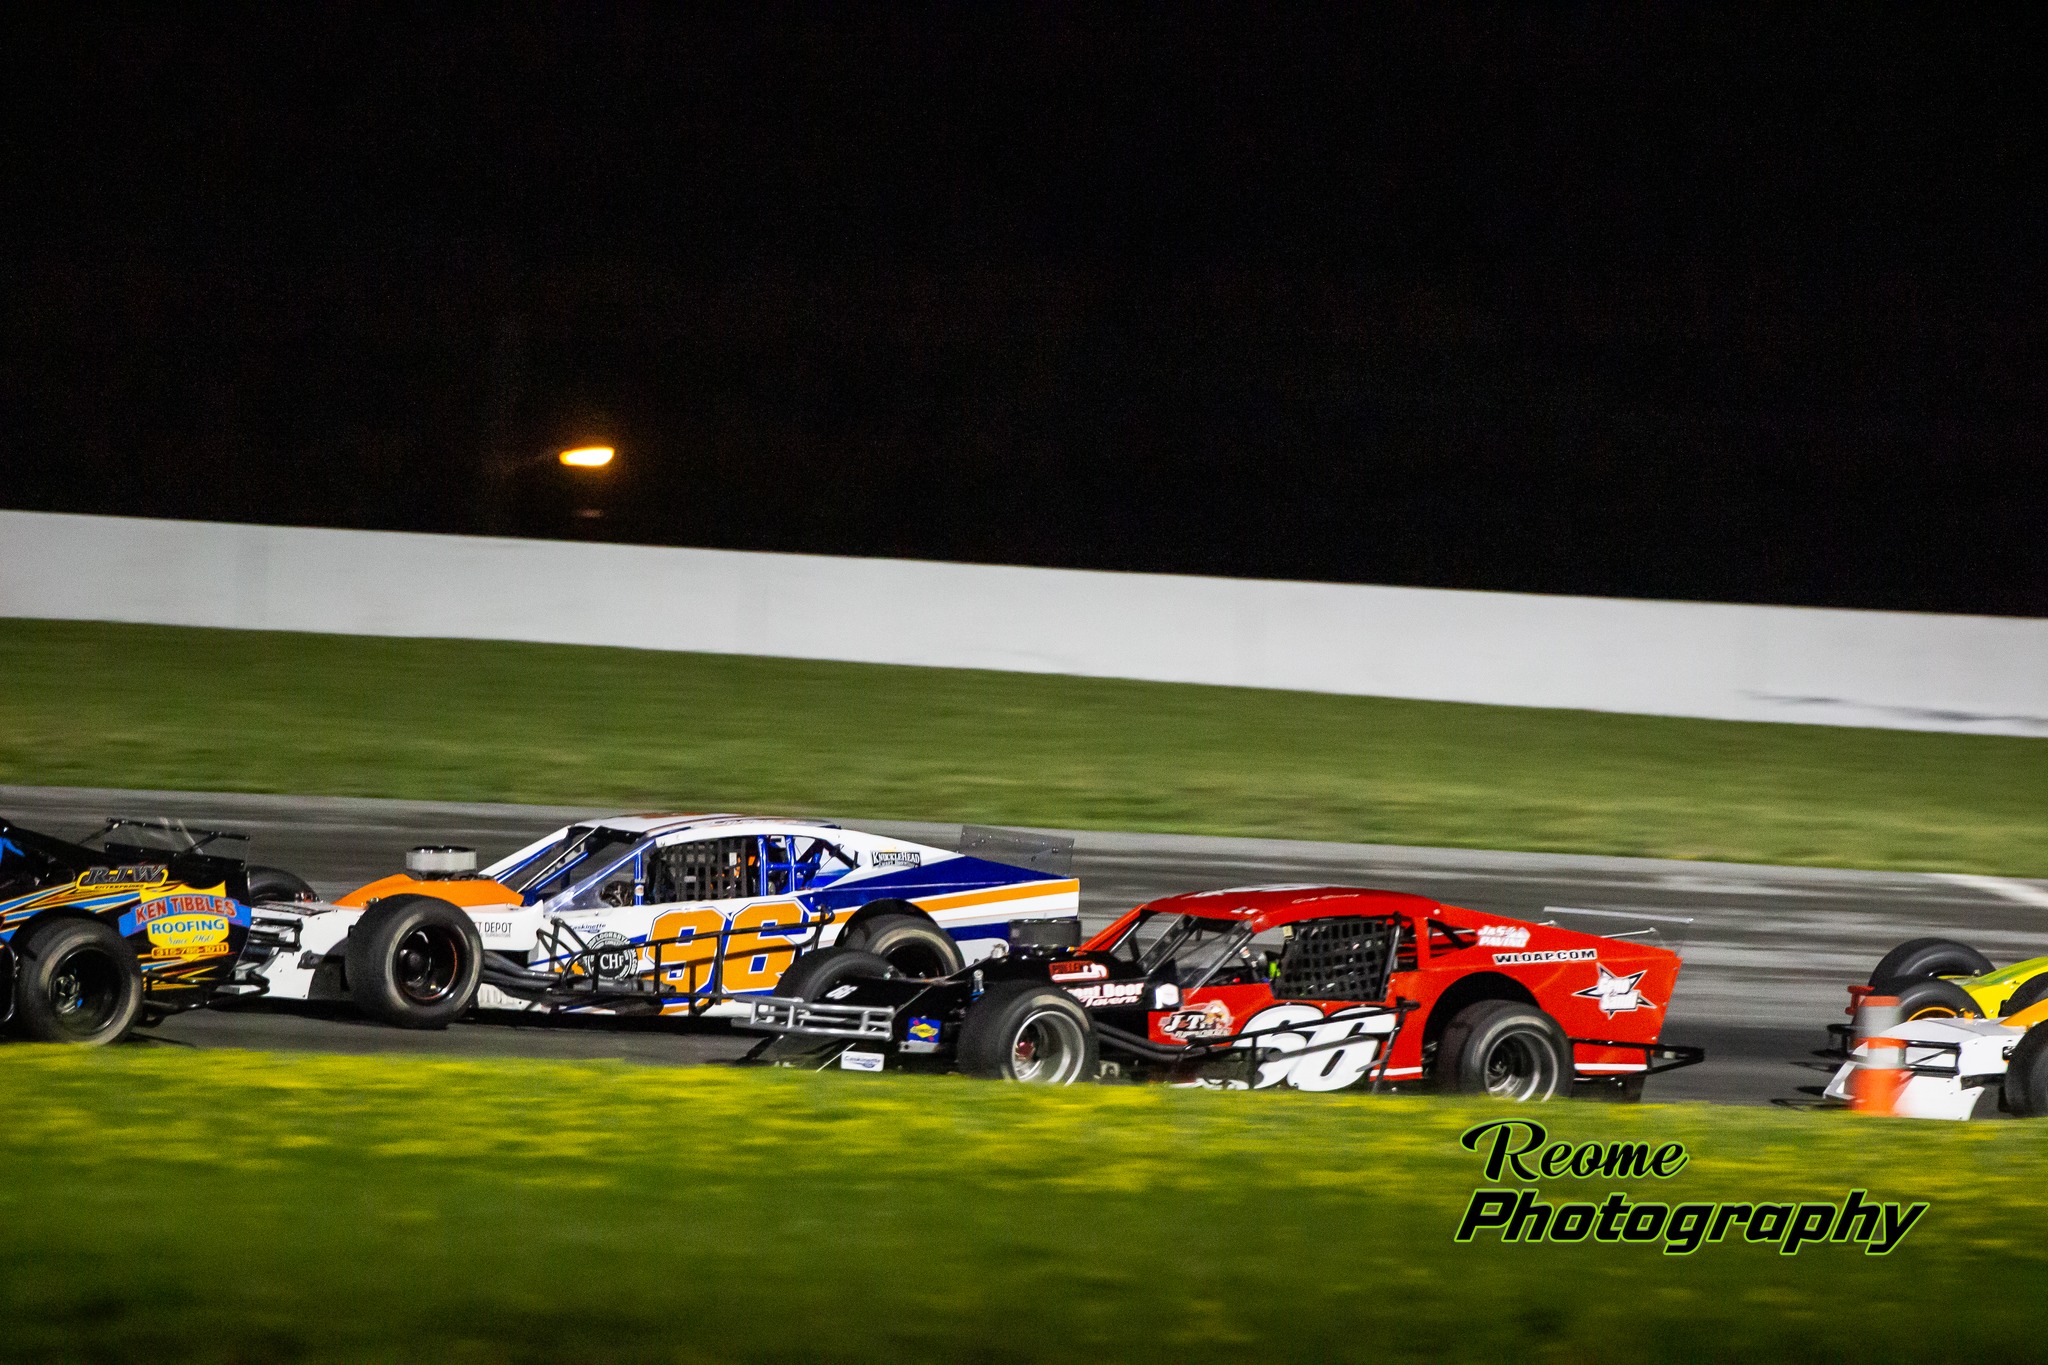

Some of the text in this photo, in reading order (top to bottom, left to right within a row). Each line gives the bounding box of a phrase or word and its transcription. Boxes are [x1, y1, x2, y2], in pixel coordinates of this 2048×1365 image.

[84, 864, 167, 884] RJW
[135, 896, 237, 924] KEN TIBBLES
[151, 918, 225, 935] ROOFING
[484, 921, 513, 934] DEPOT
[645, 901, 806, 998] 96
[1079, 995, 1139, 1008] Tavern
